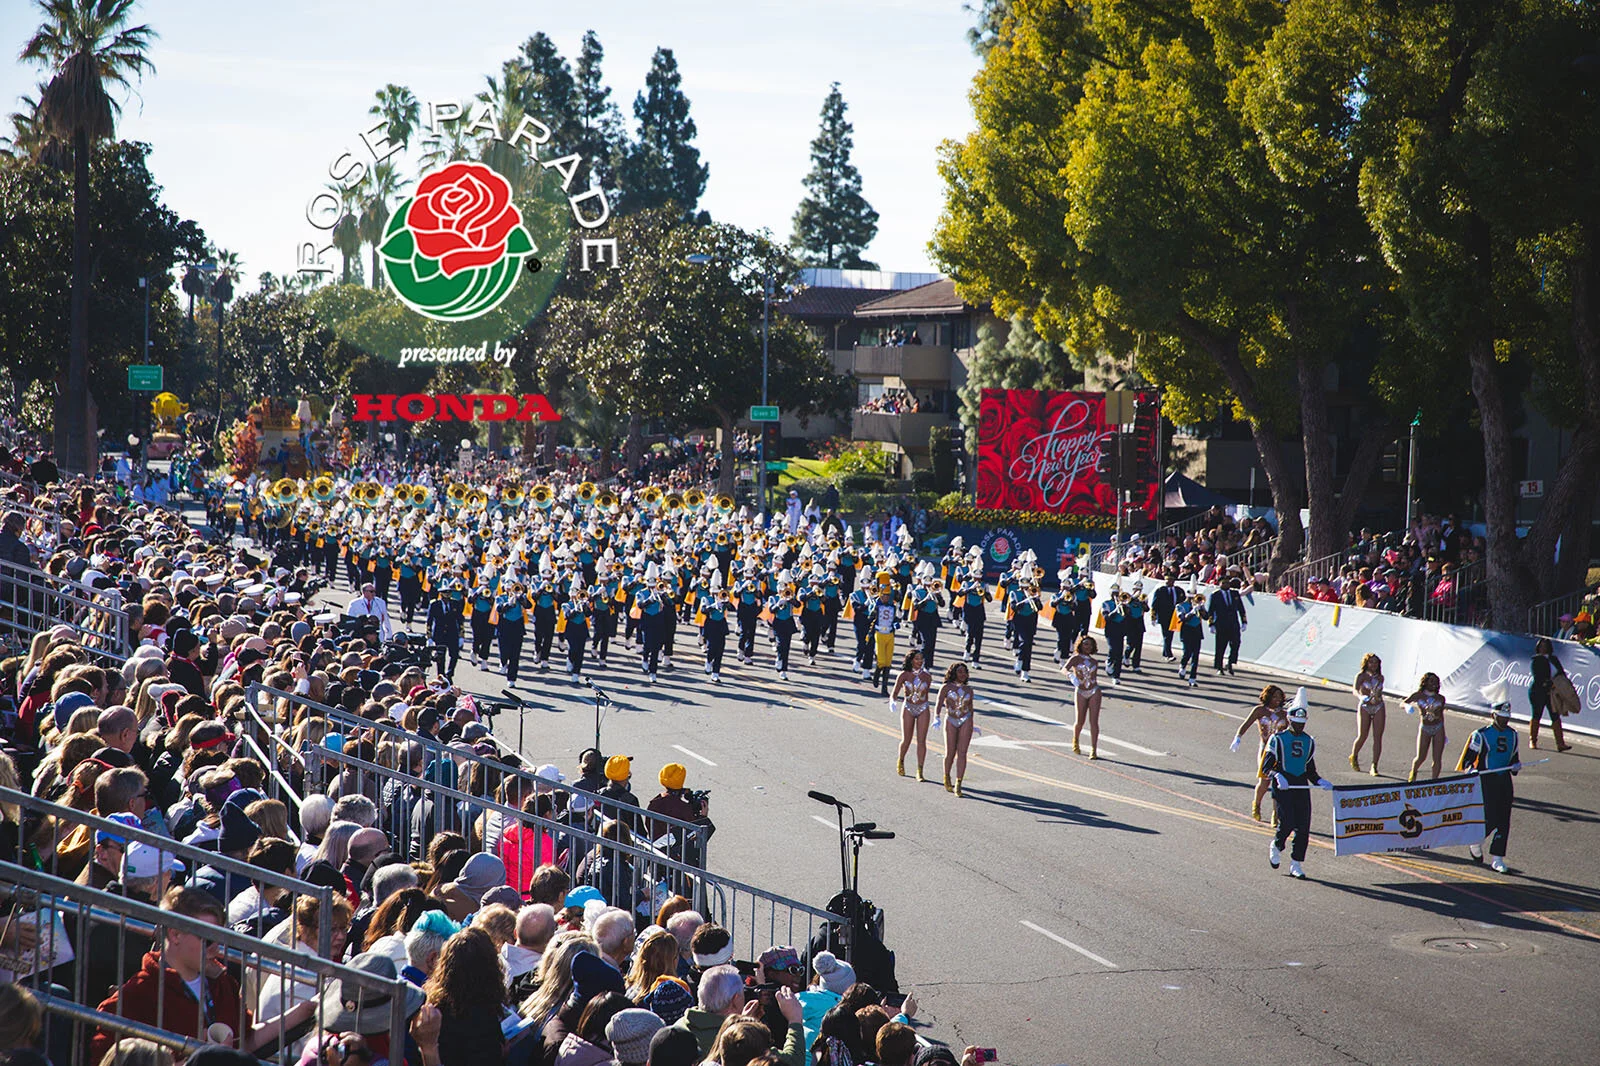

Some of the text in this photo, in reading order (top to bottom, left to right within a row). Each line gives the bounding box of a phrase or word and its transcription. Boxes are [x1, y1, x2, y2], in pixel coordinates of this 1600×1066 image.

[980, 530, 995, 554] OSE
[1291, 740, 1304, 758] S
[1497, 735, 1508, 753] S
[1340, 783, 1475, 809] SOUTHERN UNIVERSITY
[1344, 811, 1463, 834] MARCHING BAND
